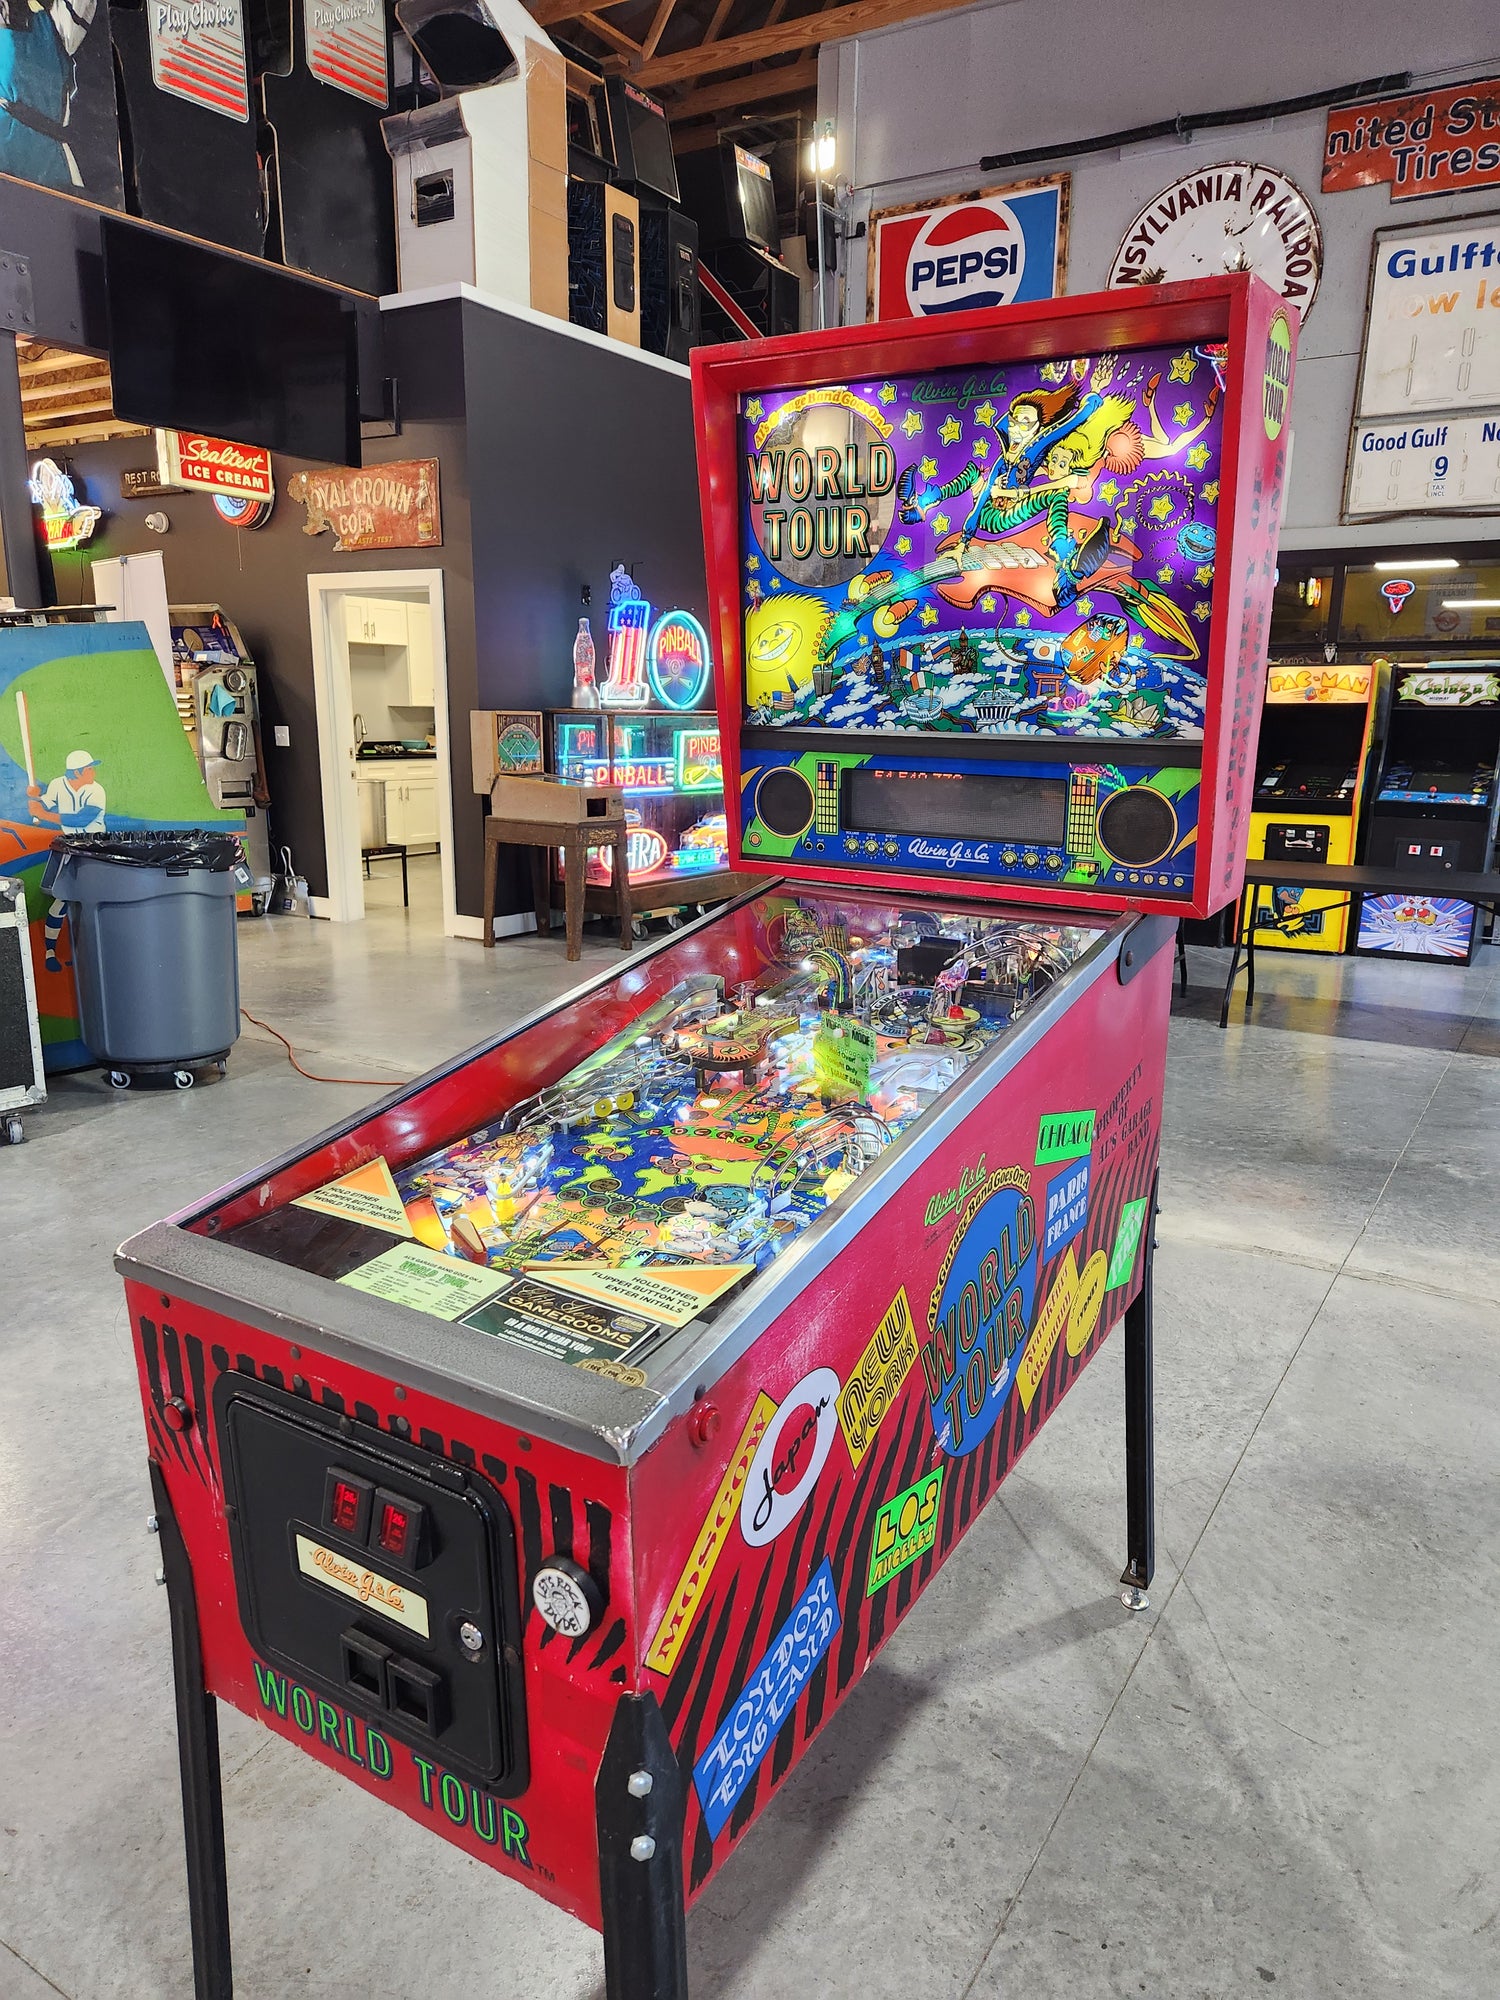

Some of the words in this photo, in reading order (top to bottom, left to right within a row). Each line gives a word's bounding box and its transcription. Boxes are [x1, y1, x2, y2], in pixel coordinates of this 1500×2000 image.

[157, 5, 235, 39] PlayChoice
[1446, 97, 1500, 136] St
[1390, 143, 1500, 183] Tires
[912, 243, 1018, 292] PEPSI
[1387, 241, 1500, 279] Gulft
[1265, 337, 1292, 388] WORLD
[1264, 380, 1285, 425] TOUR
[187, 439, 269, 474] Sealtest
[1362, 432, 1408, 452] Good
[1411, 426, 1449, 448] Gulf
[124, 471, 147, 485] REST
[188, 464, 211, 480] ICE
[216, 470, 265, 489] CREAM
[747, 441, 897, 503] WORLD
[1434, 455, 1449, 478] 9
[352, 477, 415, 515] CROWN
[339, 513, 375, 535] COLA
[764, 504, 873, 560] TOUR
[660, 624, 703, 666] PINBALL
[1270, 671, 1370, 694] PAC-MAN
[1415, 677, 1485, 704] Galaga
[596, 765, 666, 787] PNBALL
[908, 838, 948, 859] Alvin
[964, 848, 971, 856] &
[1096, 1059, 1143, 1142] PROPERTY
[1119, 1100, 1129, 1125] OF
[1121, 1096, 1153, 1142] GARAGE
[1128, 1119, 1150, 1158] BAND
[320, 1191, 352, 1202] FLIPPER
[351, 1199, 384, 1211] BUTTON
[385, 1207, 402, 1216] FOR
[328, 1187, 351, 1196] HOLD
[350, 1192, 380, 1203] EITHER
[924, 1188, 957, 1227] Alvin
[1047, 1165, 1089, 1222] PARIS
[368, 1210, 402, 1222] REPORT
[938, 1214, 969, 1285] Garage
[968, 1180, 993, 1214] Band
[994, 1168, 1013, 1186] Goes
[1046, 1196, 1088, 1249] FRANCE
[592, 1271, 632, 1288] FLIPPER
[632, 1284, 675, 1302] BUTTON
[677, 1299, 691, 1307] TO
[605, 1284, 640, 1298] ENTER
[639, 1296, 684, 1313] INITIALS
[632, 1276, 660, 1288] HOLD
[660, 1286, 698, 1301] EITHER
[921, 1195, 1037, 1404] WORLD
[1076, 1277, 1099, 1328] SYDNEY
[508, 1296, 634, 1345] GAMEROOMS
[520, 1322, 547, 1340] MALL
[546, 1331, 573, 1348] NEAR
[569, 1338, 595, 1355] YOU!
[843, 1296, 906, 1428] NEW
[944, 1286, 1028, 1450] TOUR
[851, 1332, 918, 1454] YORK
[753, 1393, 831, 1532] Japan
[657, 1407, 766, 1664] MOSCOW
[876, 1477, 939, 1557] LOS
[313, 1547, 357, 1585] Alvin
[872, 1520, 936, 1587] ANGELES
[557, 1576, 583, 1610] ROCK
[703, 1573, 831, 1774] LONDON
[709, 1606, 834, 1808] ENGLAND
[252, 1661, 393, 1780] WORLD
[411, 1755, 535, 1871] TOUR
